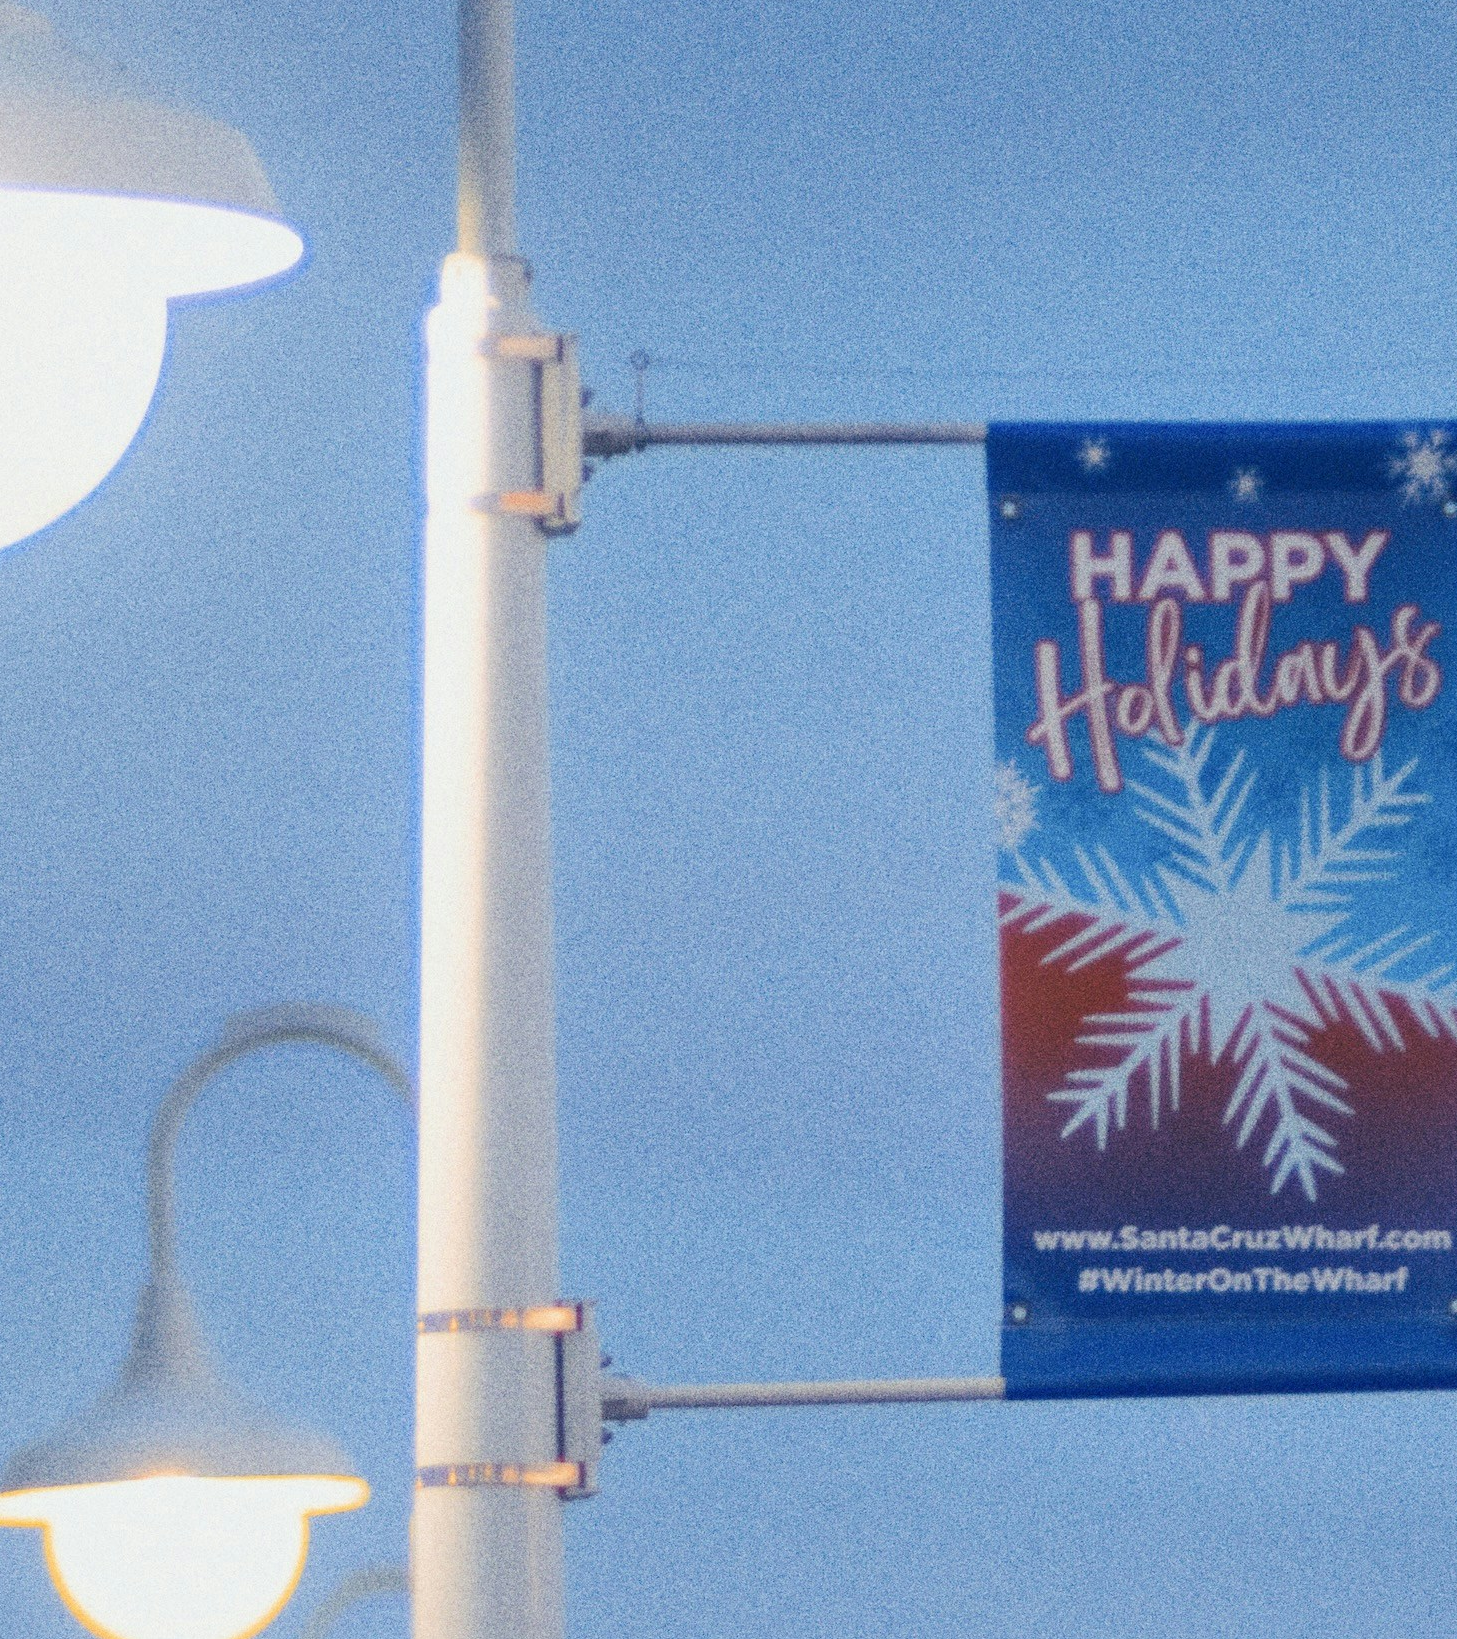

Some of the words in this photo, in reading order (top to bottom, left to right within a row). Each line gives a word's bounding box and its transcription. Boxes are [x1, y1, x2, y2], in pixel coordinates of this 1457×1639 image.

[1070, 529, 1390, 602] HAPPY
[1025, 581, 1439, 793] Holidays
[1033, 1224, 1452, 1252] www.SantaCruzWharf.com
[1078, 1266, 1409, 1294] #WinterOnTheWharf
